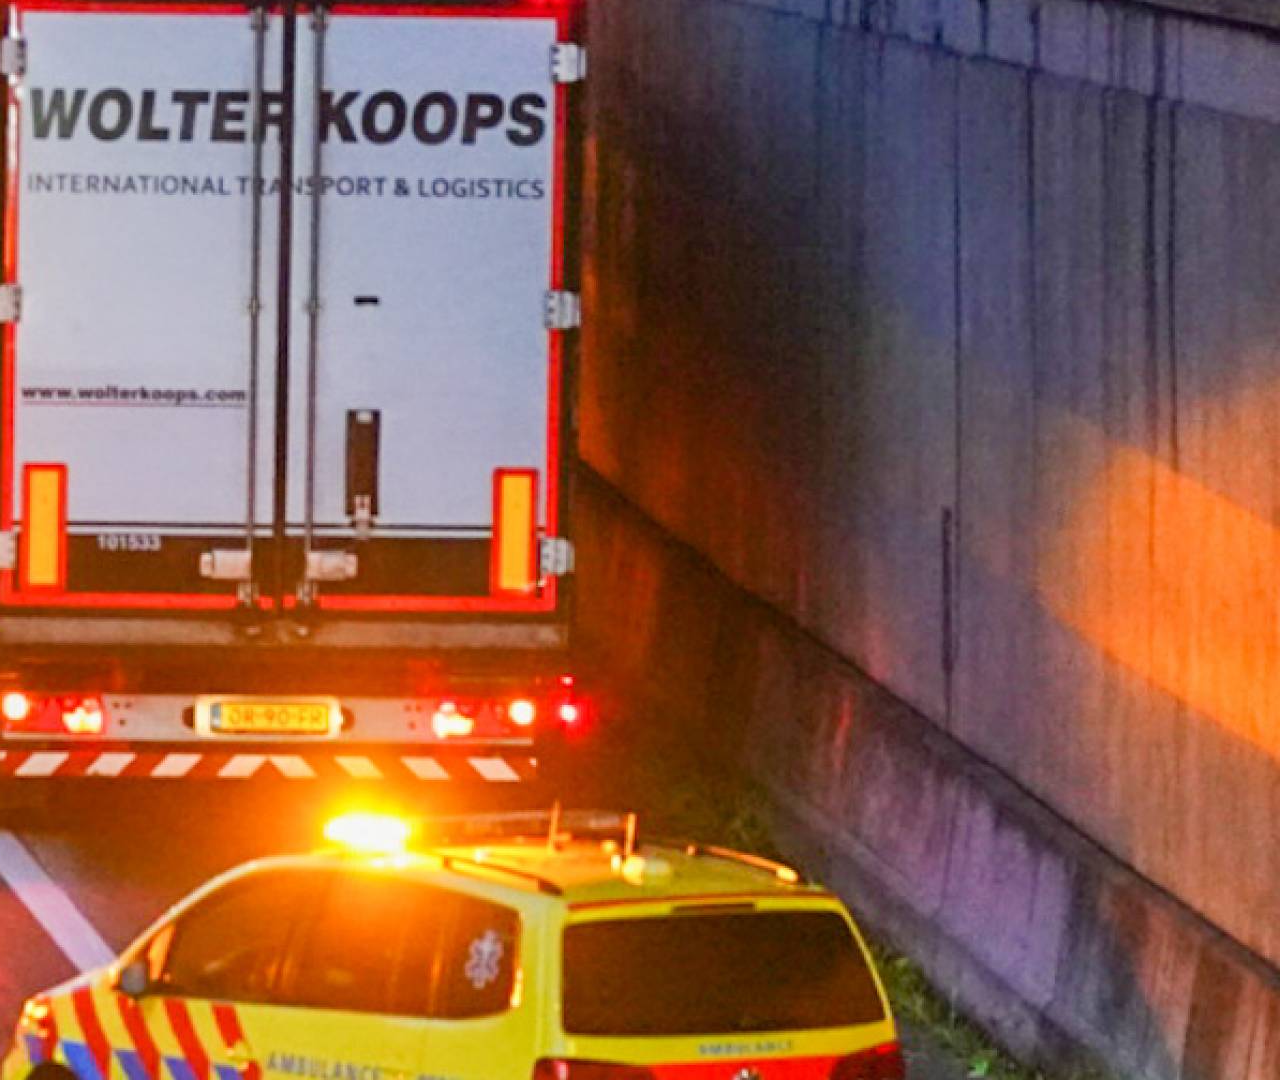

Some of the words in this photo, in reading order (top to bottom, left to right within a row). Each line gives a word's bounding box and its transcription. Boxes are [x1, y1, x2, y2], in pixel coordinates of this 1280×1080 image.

[30, 87, 293, 142] WOLTER
[317, 90, 547, 147] KOOPS
[27, 174, 232, 197] INTERNATIONAL
[393, 177, 411, 198] &
[417, 177, 546, 200] LOGISTICS
[21, 384, 247, 407] www.wolterkoops.com
[96, 533, 162, 551] 101533
